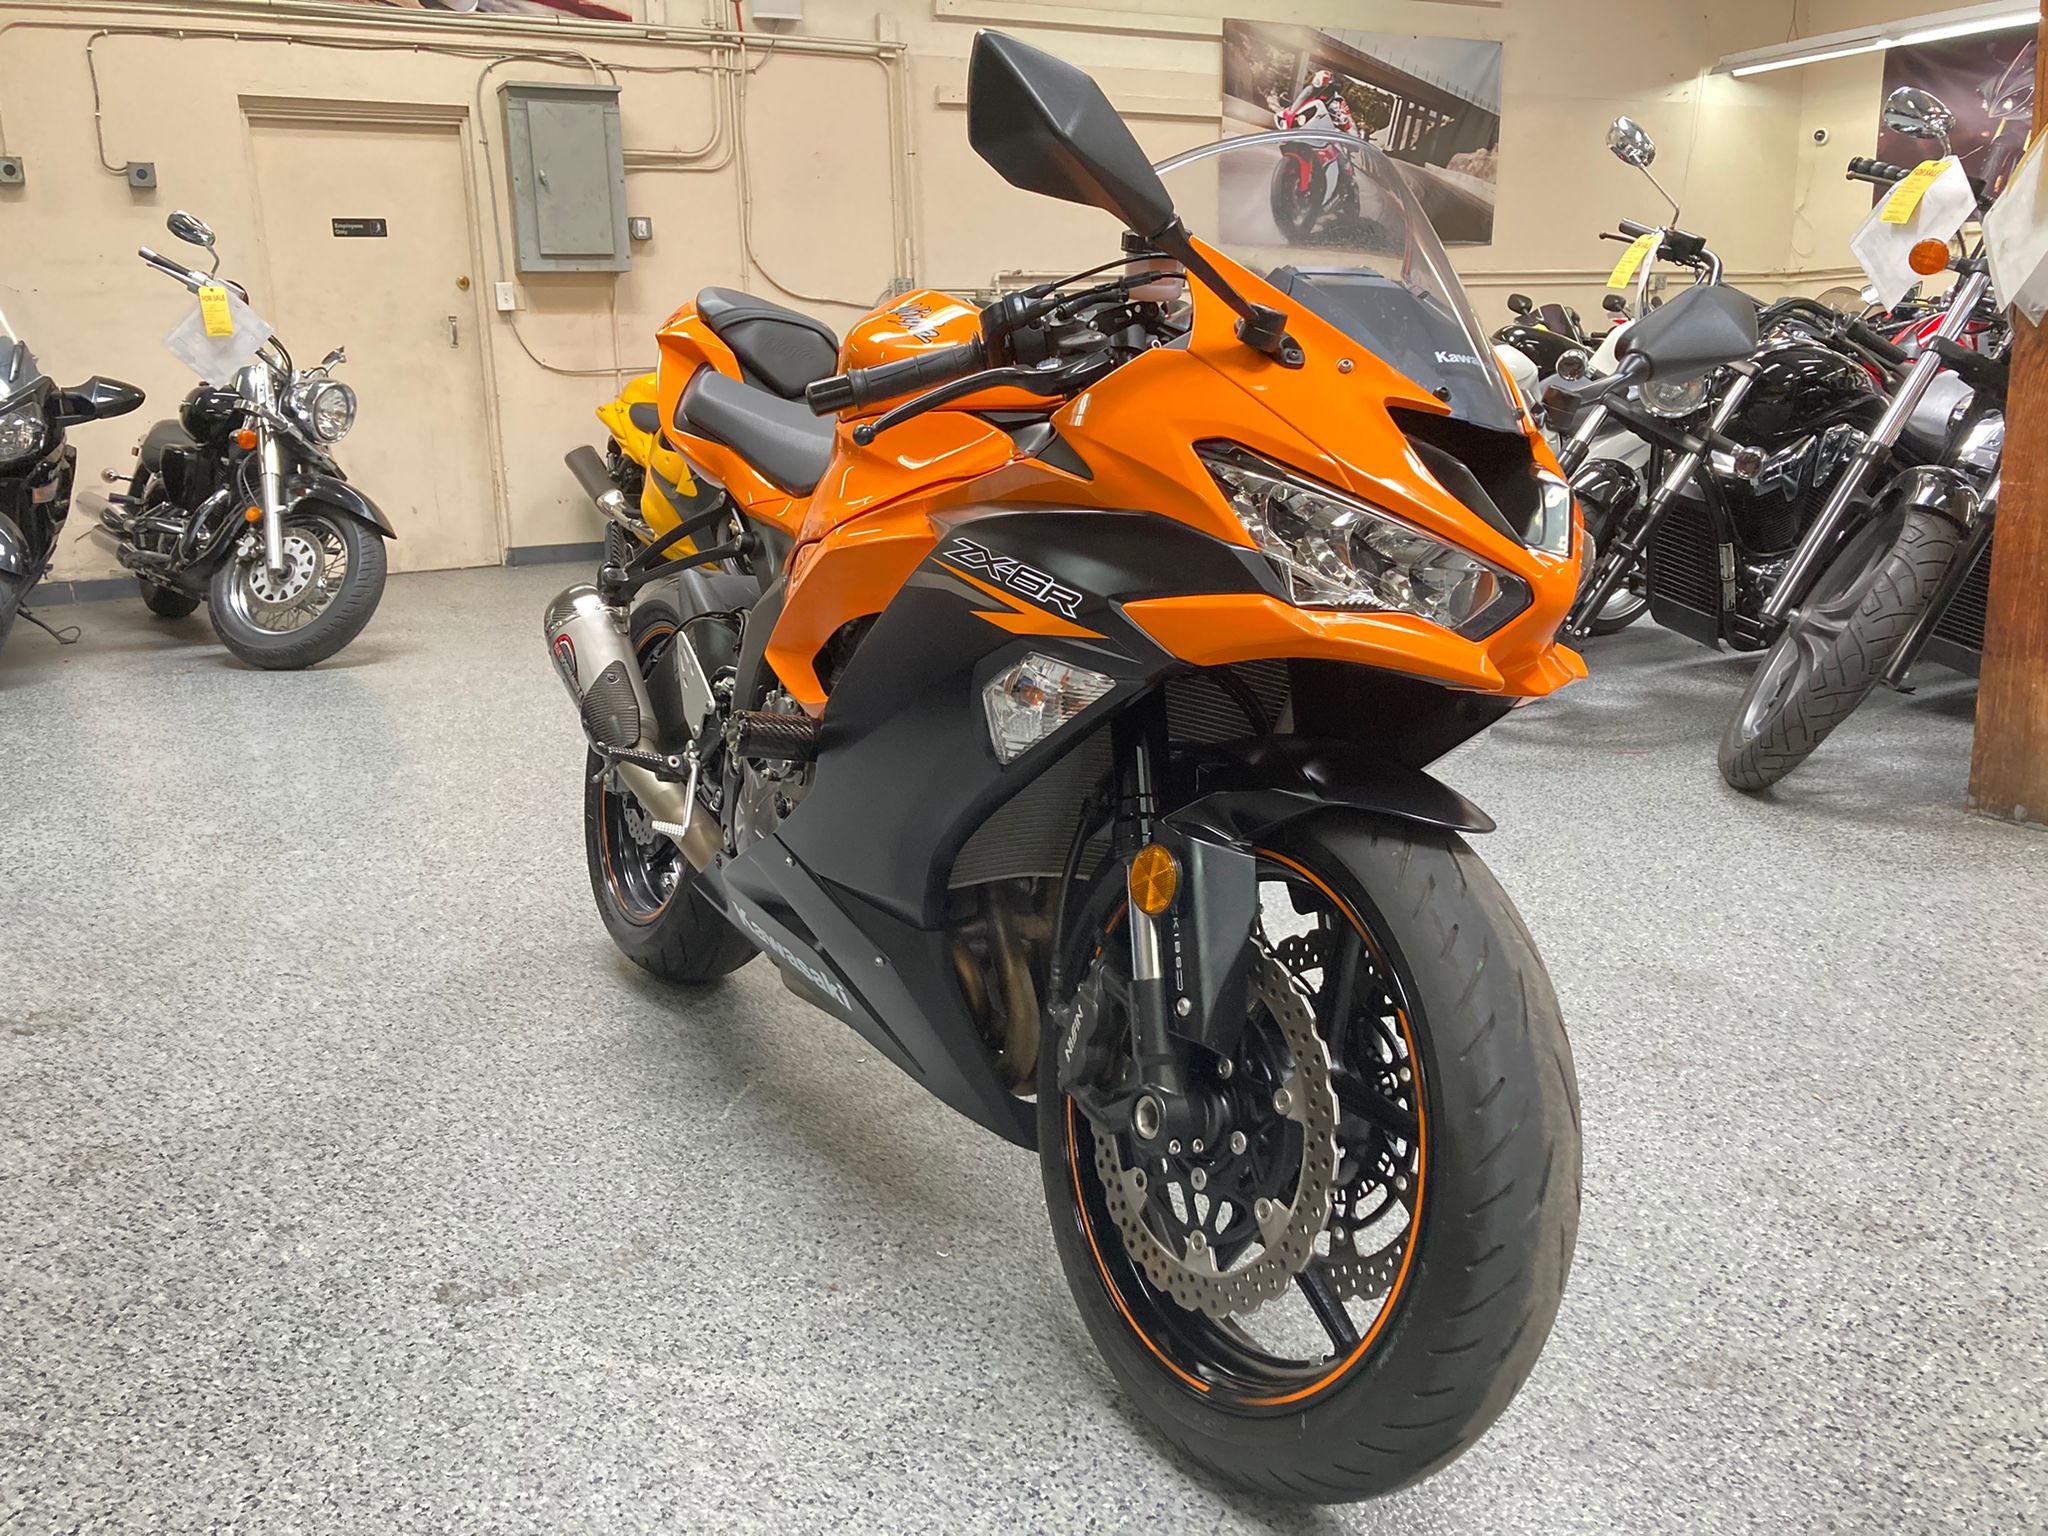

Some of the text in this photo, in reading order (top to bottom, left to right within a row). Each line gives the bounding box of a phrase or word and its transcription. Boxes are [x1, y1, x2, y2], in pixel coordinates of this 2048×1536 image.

[213, 294, 226, 302] SALE
[1434, 351, 1483, 368] Kawa
[943, 537, 1083, 619] ZX-6R
[732, 900, 853, 1011] Kawasaki
